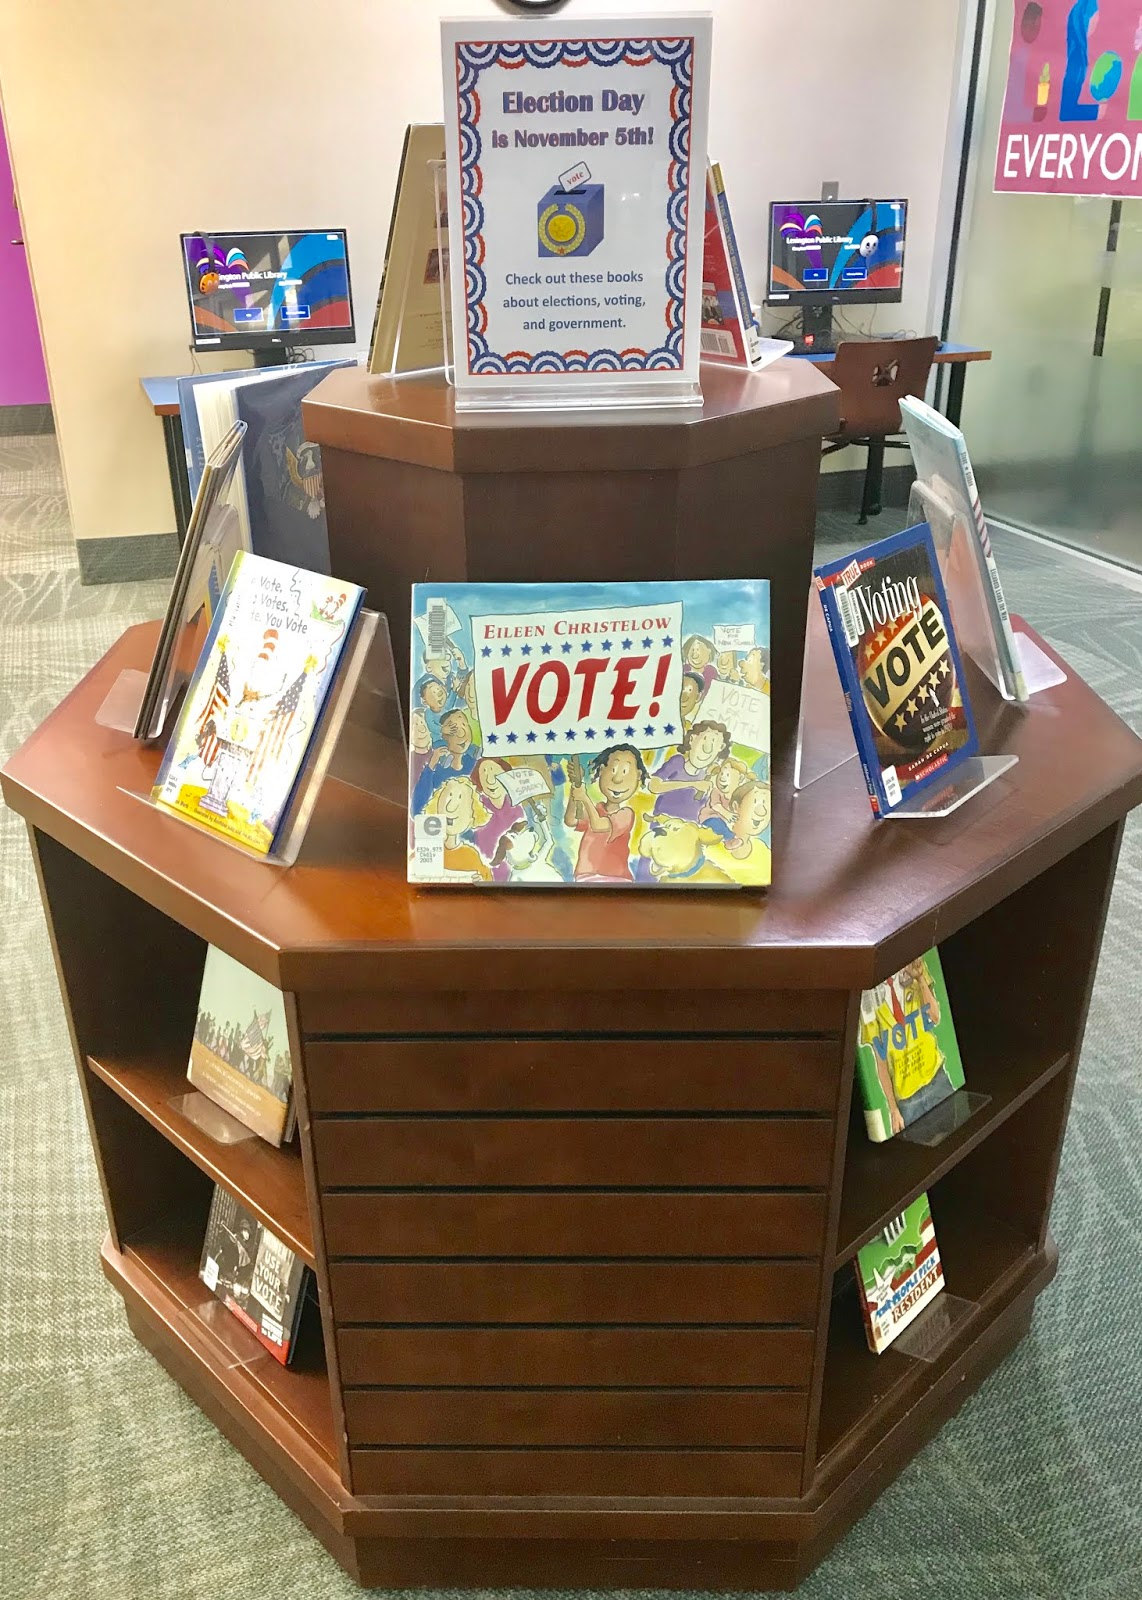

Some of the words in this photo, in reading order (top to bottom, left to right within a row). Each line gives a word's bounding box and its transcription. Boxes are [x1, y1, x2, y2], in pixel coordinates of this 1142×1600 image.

[502, 90, 593, 113] Election
[601, 89, 645, 116] Day
[491, 130, 509, 148] is
[514, 128, 609, 148] November
[615, 126, 654, 146] 5th!
[566, 170, 584, 185] vote
[718, 201, 727, 217] THE
[721, 218, 730, 233] KID
[724, 233, 735, 254] WHO
[218, 273, 241, 282] ington
[242, 271, 263, 280] Public
[264, 271, 287, 279] Library
[505, 272, 542, 285] Check
[545, 273, 566, 284] out
[569, 271, 603, 283] these
[607, 271, 644, 283] books
[730, 255, 744, 290] BECAME
[503, 296, 539, 308] about
[542, 295, 601, 308] elections,
[604, 294, 646, 307] voting,
[738, 291, 752, 329] PRESIDEN
[523, 318, 546, 330] and
[548, 318, 626, 332] government.
[842, 563, 860, 587] TRUE
[989, 568, 1000, 589] Elizabeth
[856, 575, 924, 633] Voting
[266, 612, 283, 628] You
[286, 617, 308, 634] Vote
[484, 624, 545, 640] EILEEN
[554, 617, 672, 636] CHRISTELOW
[864, 607, 945, 708] VOTE
[491, 653, 672, 726] VOTE!
[721, 686, 761, 713] VOTE
[908, 758, 925, 772] SARAH
[933, 741, 949, 755] CAPUA
[919, 755, 948, 778] SCHOLASTIC
[506, 770, 534, 779] VOTE
[424, 816, 442, 836] e
[872, 1003, 935, 1061] VOTE
[265, 1249, 280, 1274] USE
[919, 1256, 936, 1278] PICK
[260, 1262, 281, 1292] YOUR
[256, 1277, 282, 1313] VOTE
[893, 1267, 938, 1323] RESIDENT
